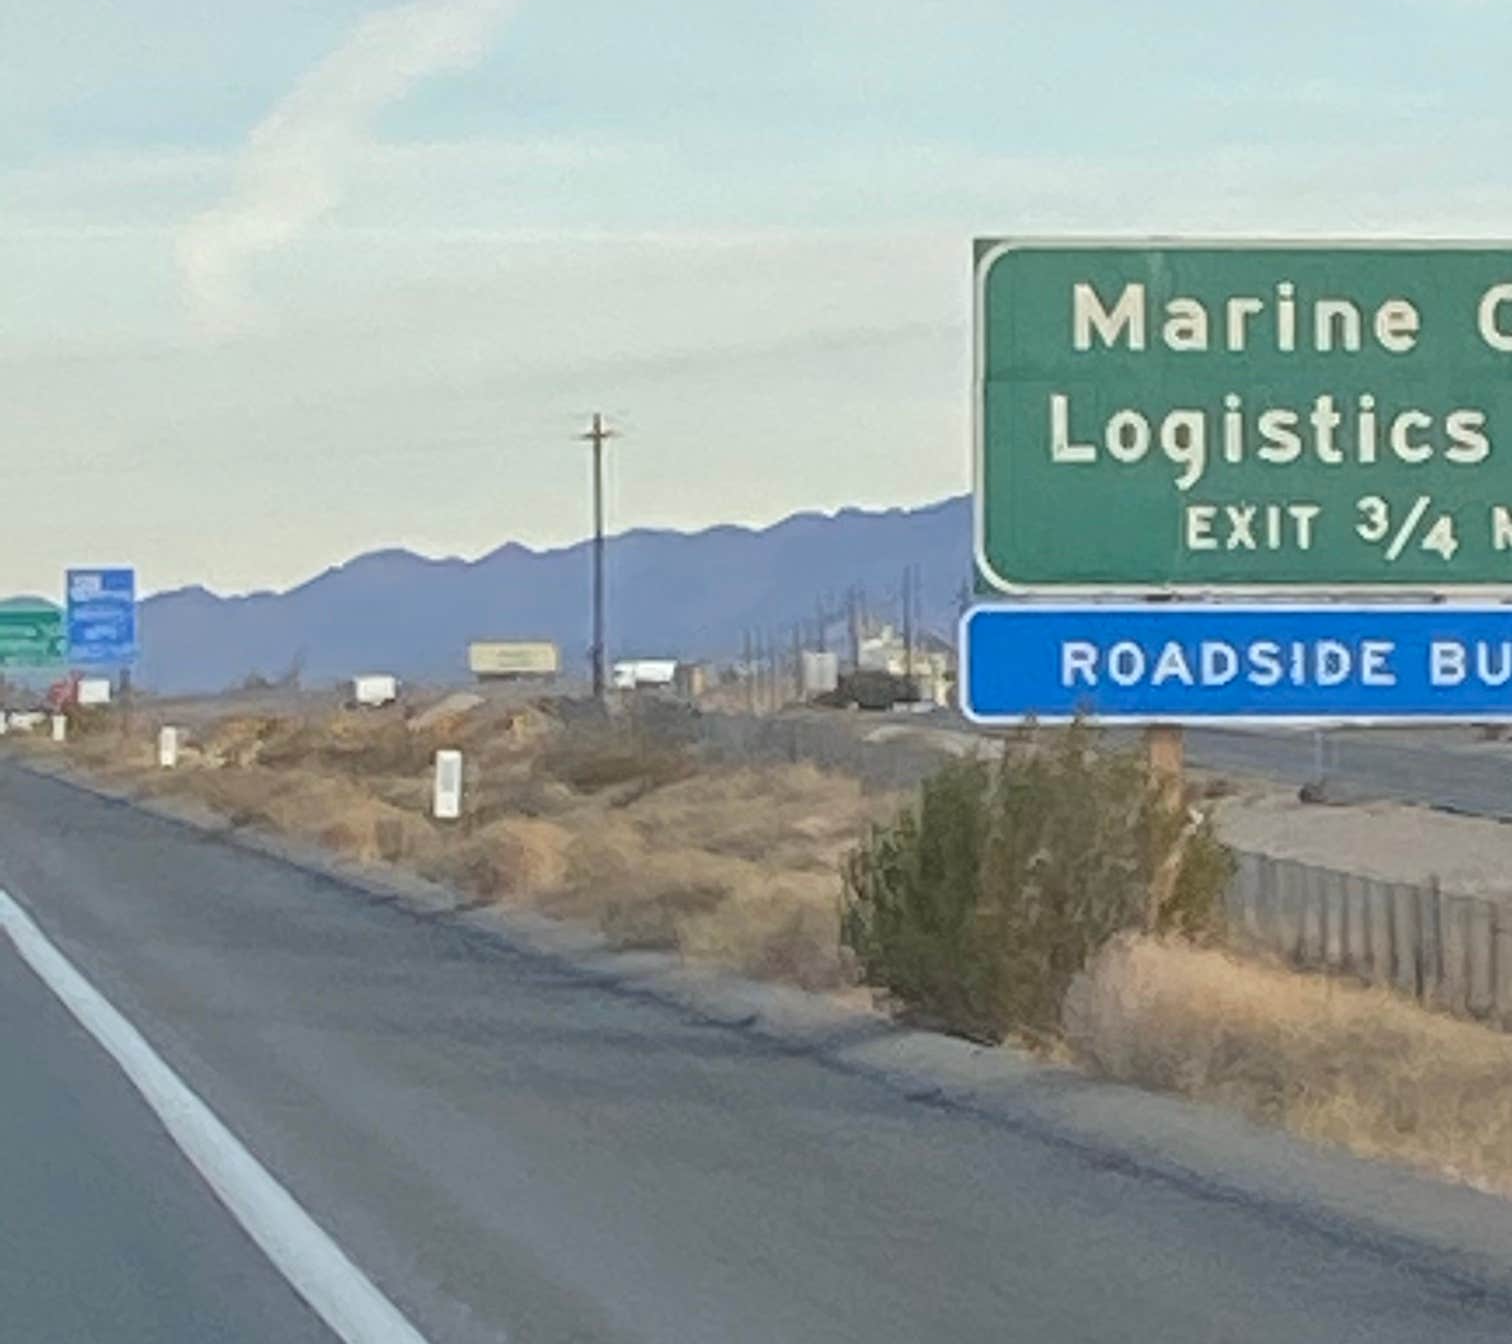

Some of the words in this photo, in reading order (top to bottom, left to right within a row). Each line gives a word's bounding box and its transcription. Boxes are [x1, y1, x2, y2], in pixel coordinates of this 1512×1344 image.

[1072, 282, 1420, 353] Marine
[1049, 393, 1490, 492] Logistics
[1186, 504, 1321, 551] EXIT
[1354, 495, 1459, 561] 3/4
[1062, 641, 1396, 686] ROADSIDE
